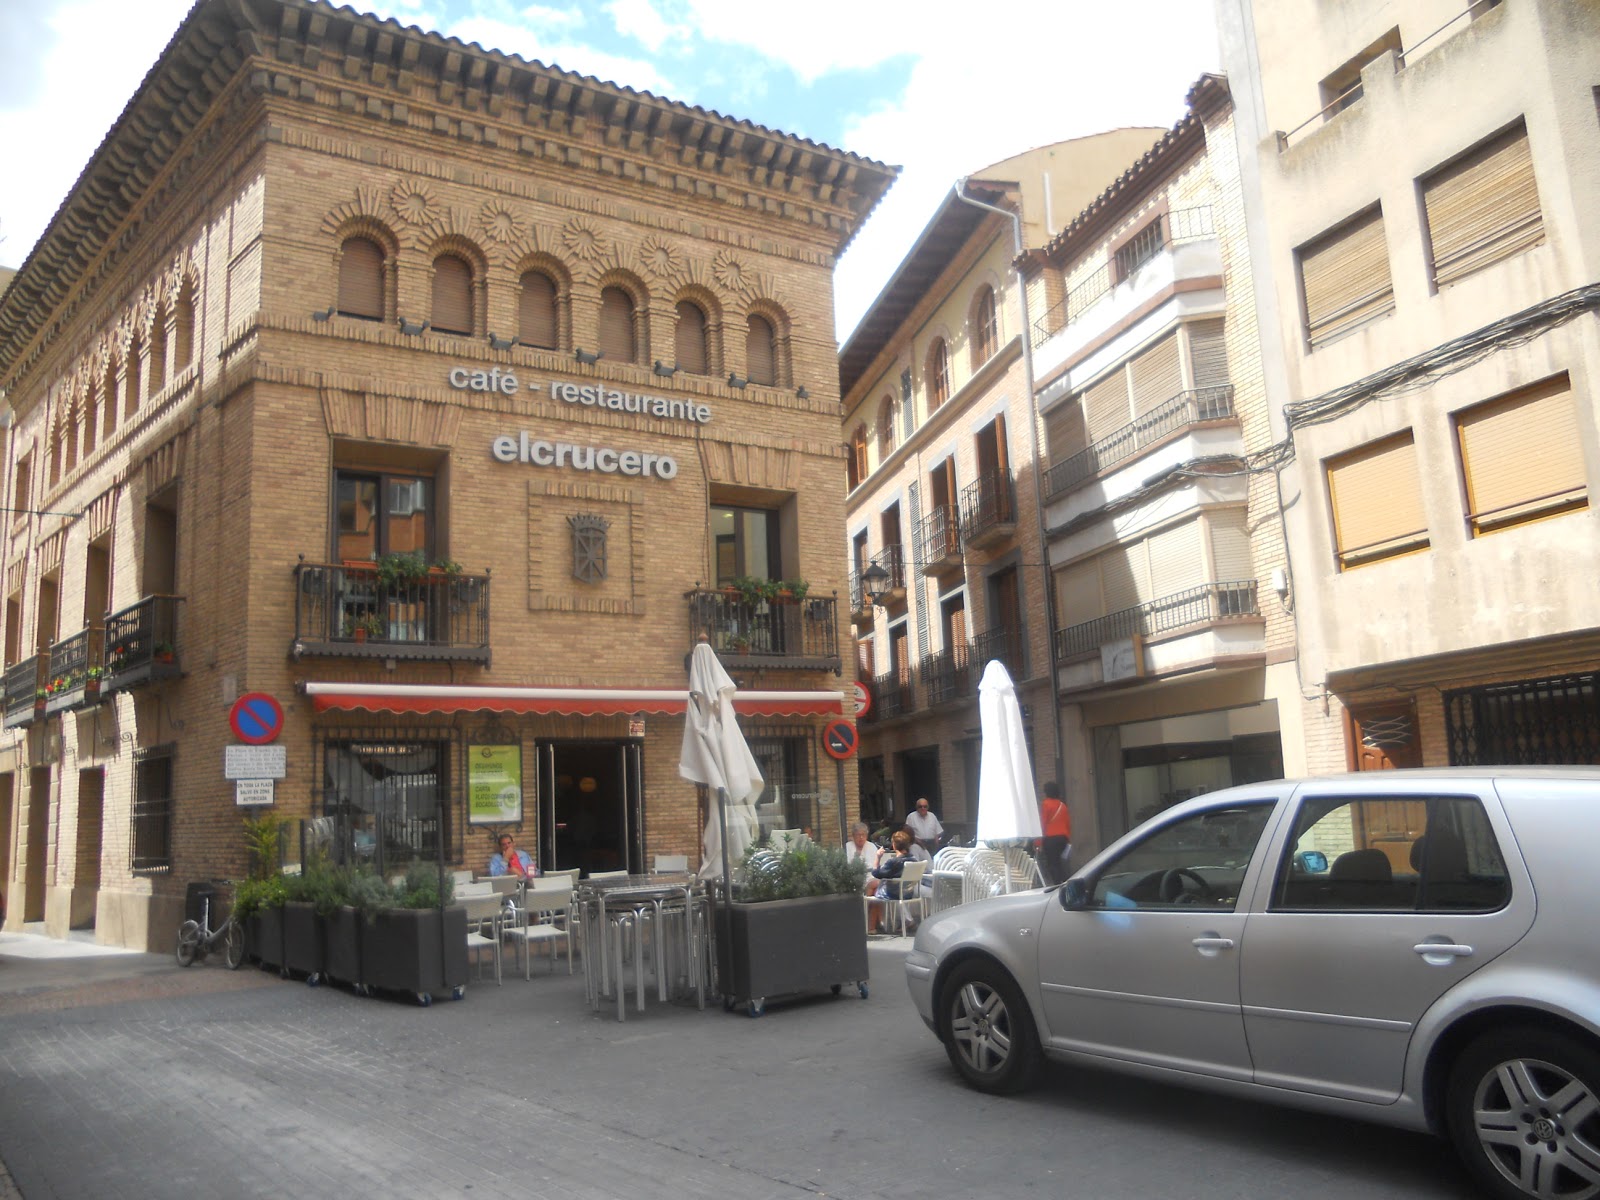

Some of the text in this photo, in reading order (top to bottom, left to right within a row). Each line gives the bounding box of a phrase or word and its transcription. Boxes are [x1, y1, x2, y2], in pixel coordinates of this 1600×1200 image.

[450, 366, 518, 395] café
[551, 380, 712, 424] restaurante
[493, 430, 678, 480] elcrucero
